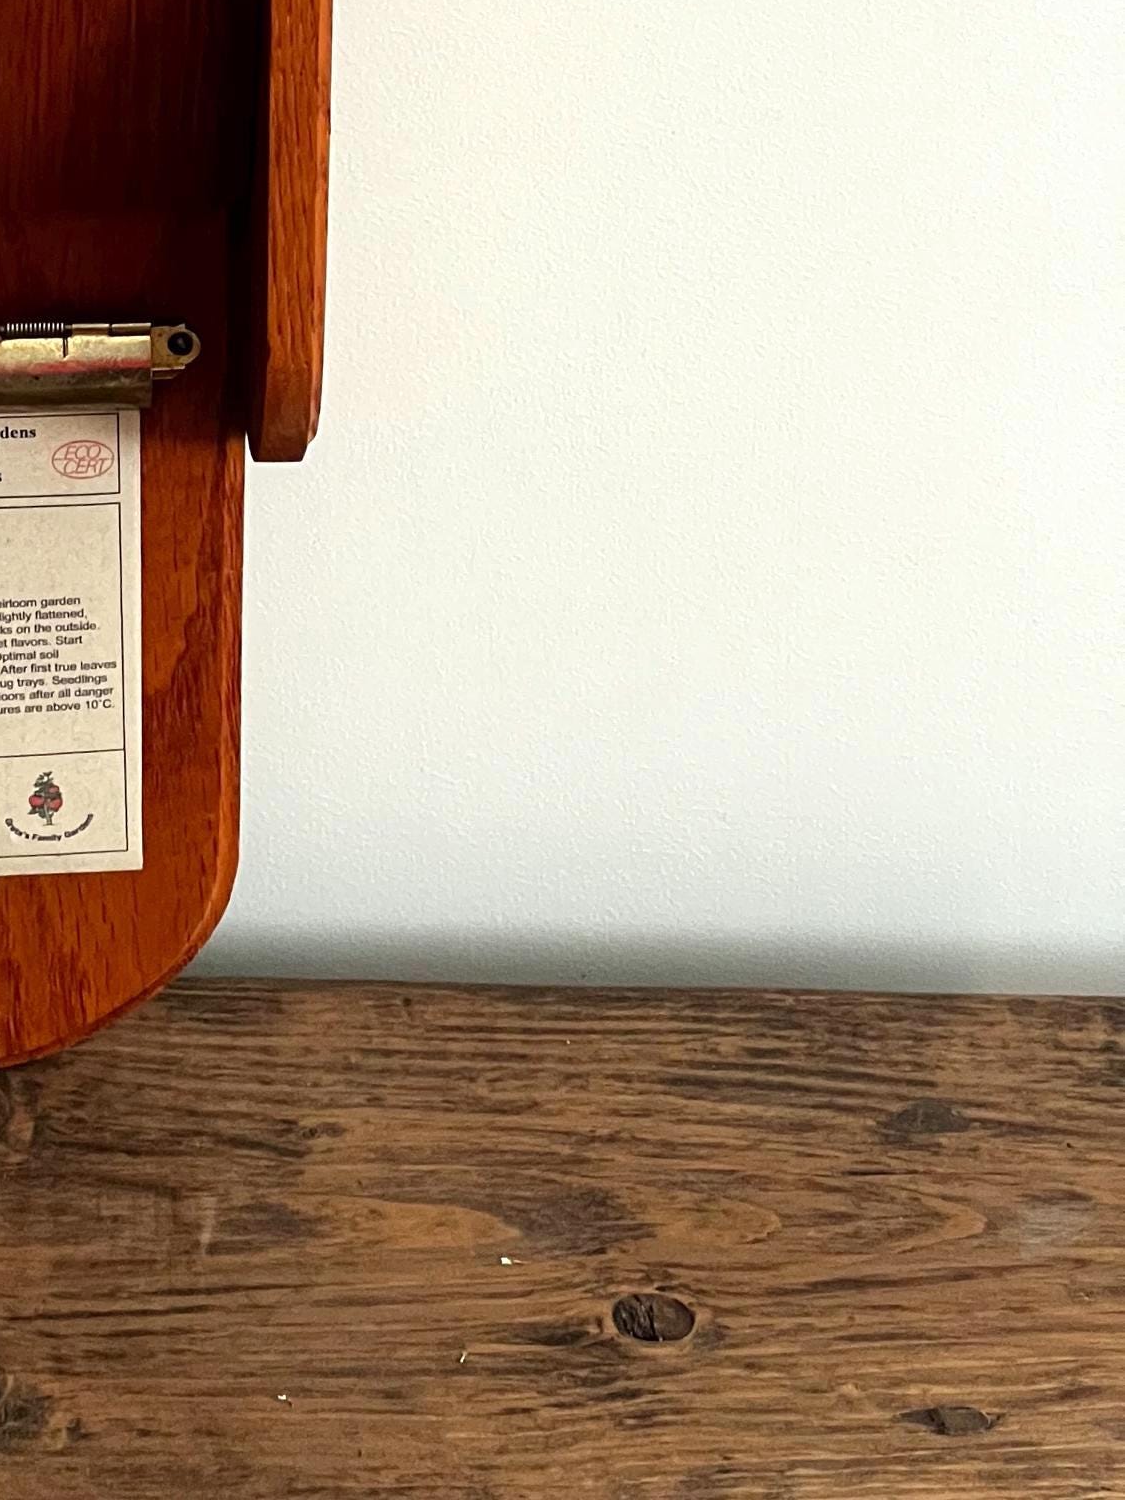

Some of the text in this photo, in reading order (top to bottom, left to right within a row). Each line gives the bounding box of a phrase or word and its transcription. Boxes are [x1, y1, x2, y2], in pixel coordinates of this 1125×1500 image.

[64, 445, 101, 460] ECO
[64, 458, 111, 475] CERT
[40, 596, 81, 609] garden
[15, 625, 31, 635] on
[34, 623, 52, 633] the
[55, 635, 83, 646] Start
[39, 649, 59, 660] soil
[0, 664, 28, 675] After
[30, 663, 51, 673] first
[54, 663, 77, 672] true
[80, 661, 117, 671] leaves
[52, 674, 107, 685] Seedlings
[29, 689, 55, 700] after
[57, 688, 71, 698] all
[74, 687, 114, 699] danger
[24, 704, 43, 713] are
[45, 702, 81, 712] above
